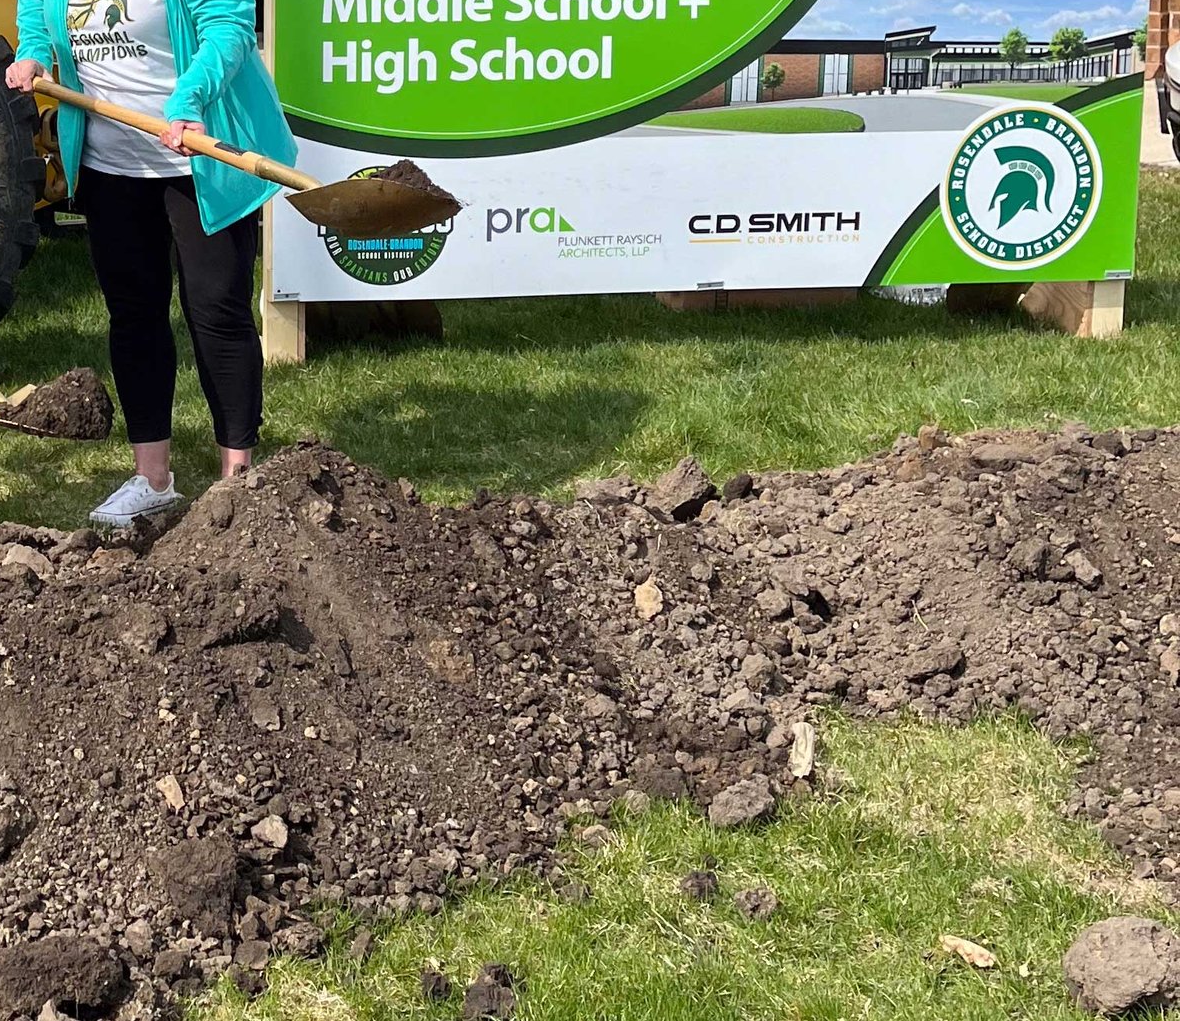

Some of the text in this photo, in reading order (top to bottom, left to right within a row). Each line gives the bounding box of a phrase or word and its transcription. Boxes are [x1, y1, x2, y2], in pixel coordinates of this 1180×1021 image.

[73, 44, 149, 63] HAMPIONS
[322, 35, 613, 94] High School
[951, 113, 1092, 190] ROSENDALE BRANDON
[486, 206, 556, 242] pra
[688, 211, 861, 234] C.D. SMITH
[956, 204, 1085, 259] SCHOOL DISTRICT
[557, 234, 662, 247] PLUNKETT RAYSICH
[747, 233, 861, 245] CONSTRUCTION
[326, 235, 343, 257] OUR
[393, 266, 414, 282] OUR
[414, 236, 444, 272] FUTURE
[383, 251, 414, 260] DISTRICT
[631, 246, 650, 257] LLP
